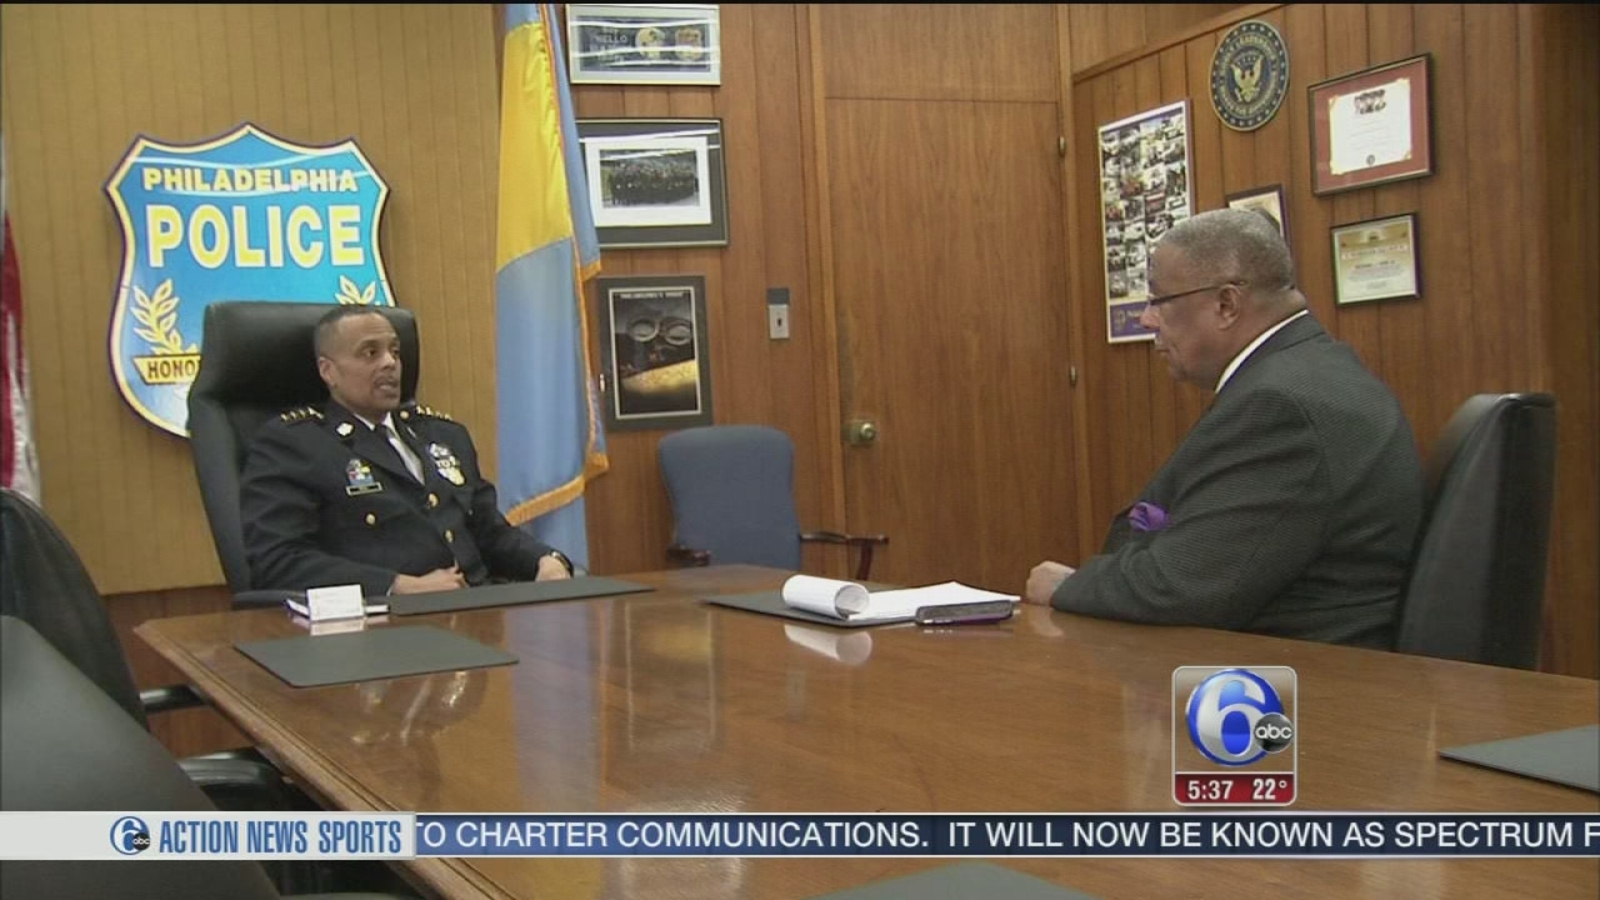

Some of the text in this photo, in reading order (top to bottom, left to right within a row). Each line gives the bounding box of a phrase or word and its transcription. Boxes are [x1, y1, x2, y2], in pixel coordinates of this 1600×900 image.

[143, 168, 358, 192] PHILADELPHIA
[146, 204, 364, 269] POLICE
[147, 358, 200, 379] HONO
